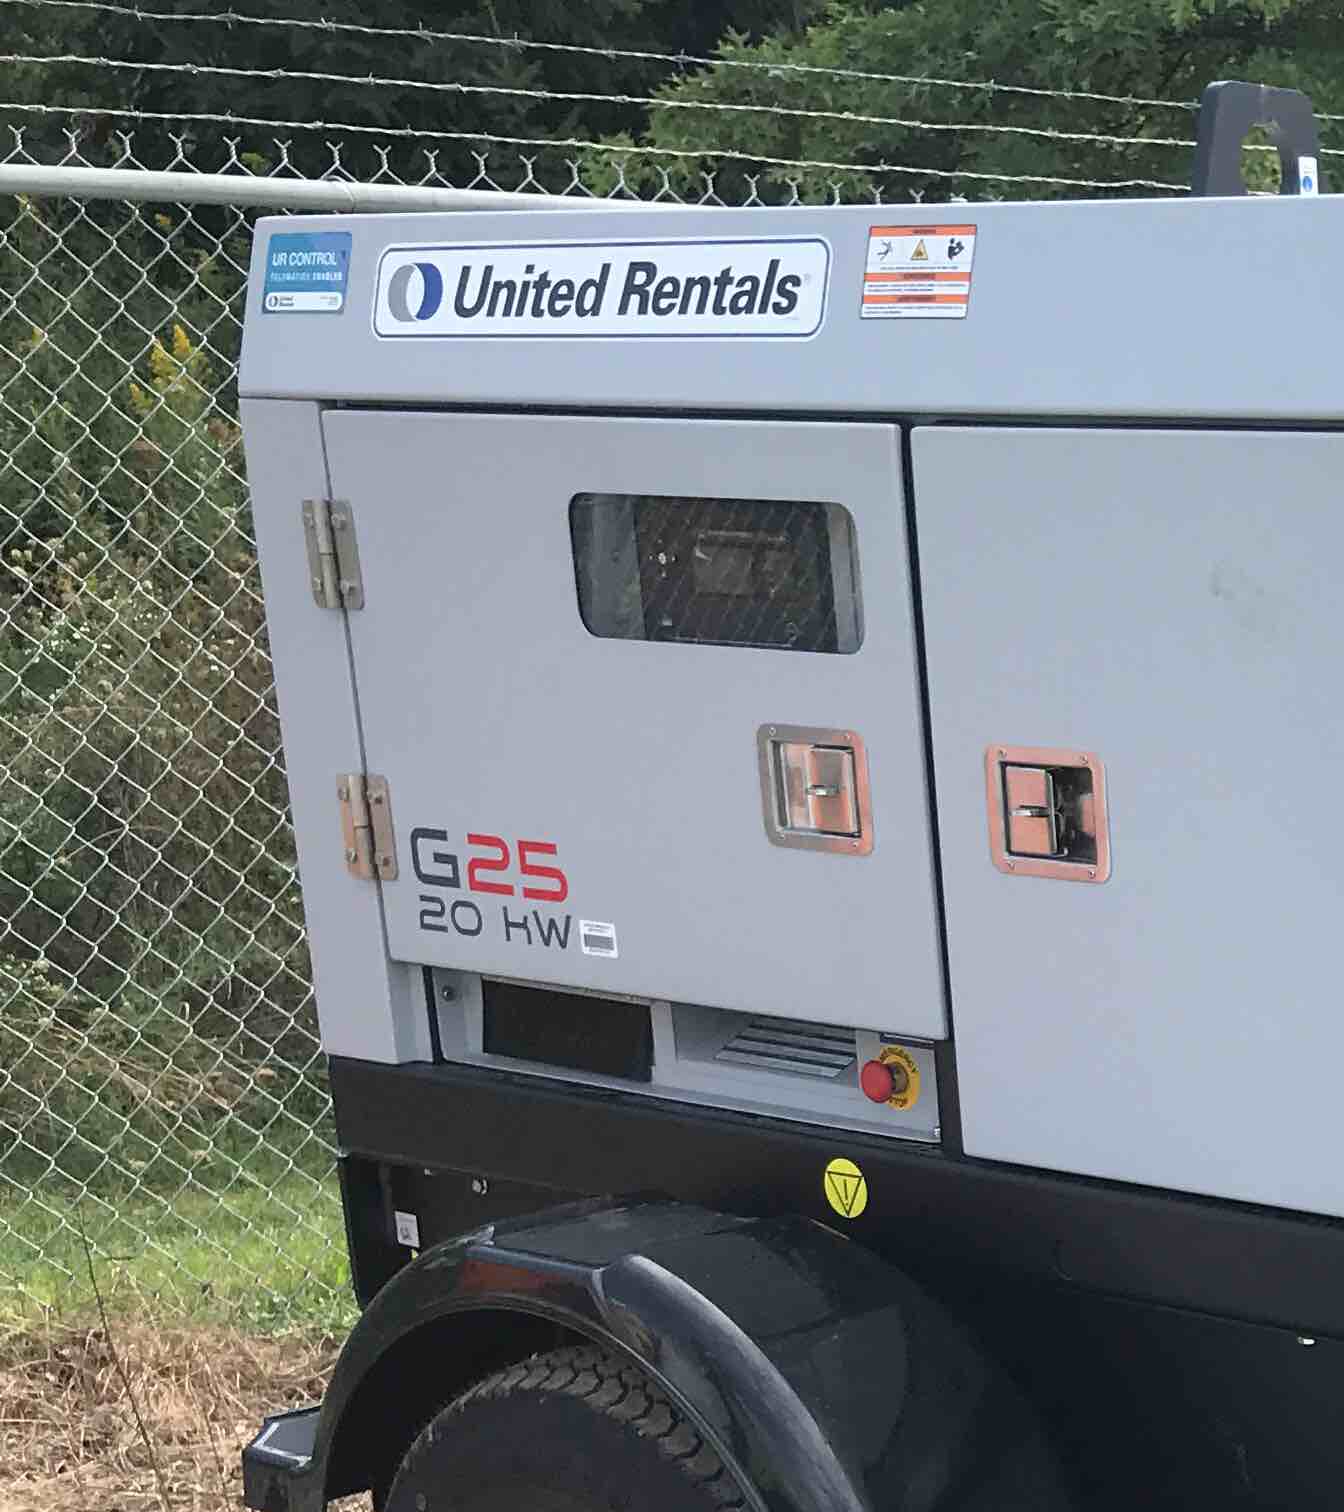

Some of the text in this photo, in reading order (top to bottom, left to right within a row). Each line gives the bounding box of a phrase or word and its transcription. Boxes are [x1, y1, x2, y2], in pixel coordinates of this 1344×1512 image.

[272, 251, 337, 266] UR CONTROL
[454, 258, 801, 319] United Rentals
[410, 827, 569, 904] G25
[418, 894, 483, 937] 20
